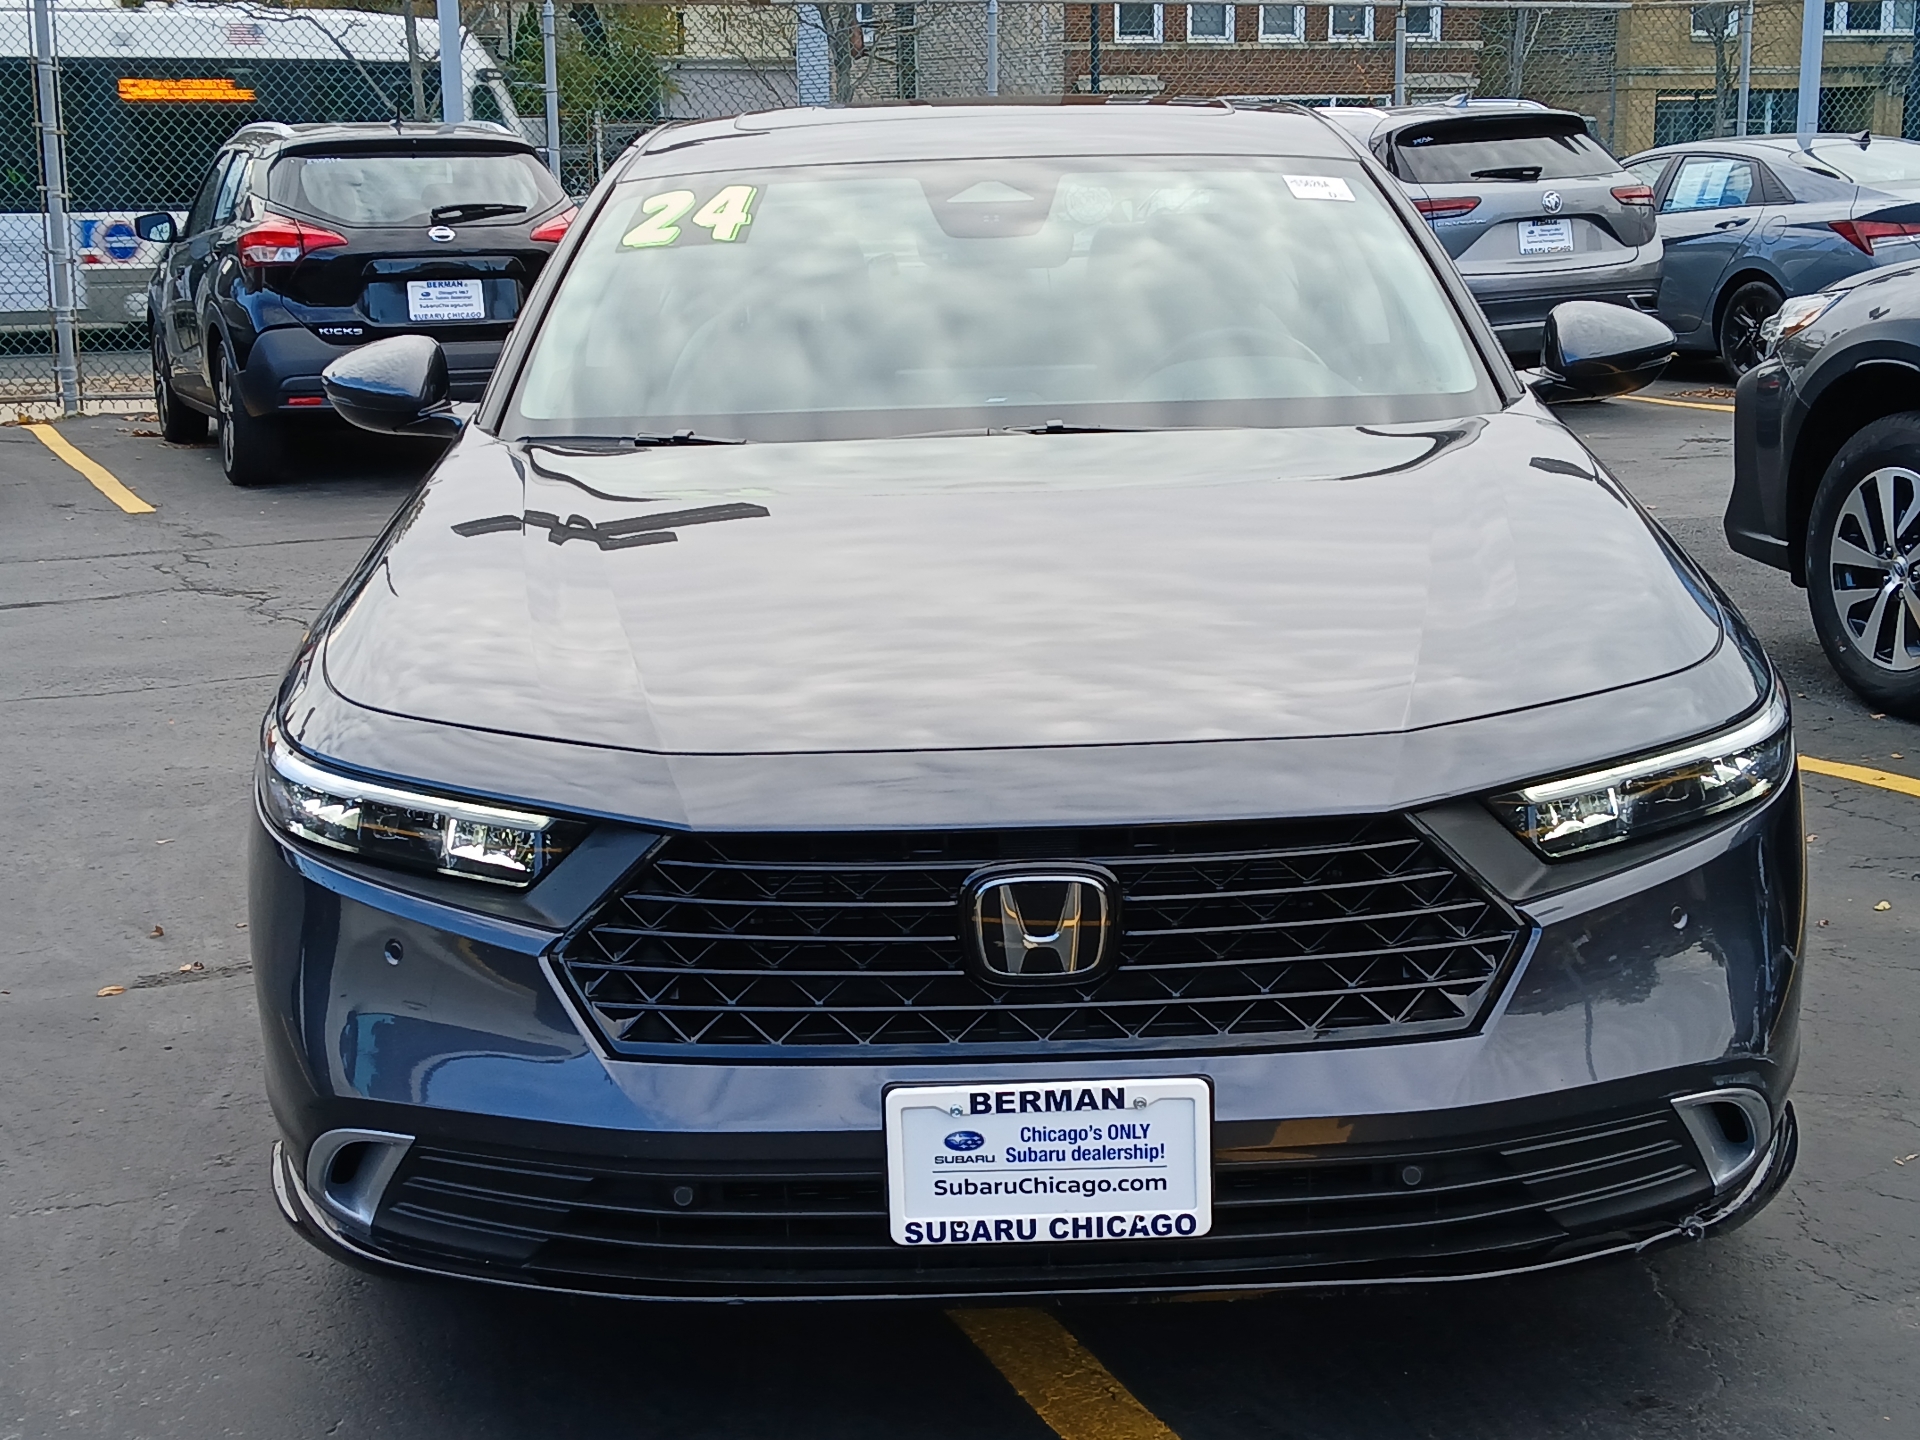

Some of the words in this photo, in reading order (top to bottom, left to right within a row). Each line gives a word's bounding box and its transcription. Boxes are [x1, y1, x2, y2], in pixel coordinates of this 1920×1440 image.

[622, 184, 757, 248] 24
[318, 327, 363, 335] KICKS
[969, 1088, 1126, 1115] BERMAN
[1020, 1125, 1103, 1145] Chicago's
[1107, 1123, 1151, 1140] ONLY
[934, 1154, 996, 1165] SUBARU
[1005, 1146, 1066, 1164] Subaru
[1071, 1143, 1166, 1163] dealership!
[933, 1176, 1168, 1197] SubaruChicago.com
[904, 1219, 1038, 1244] SUBARU
[1048, 1213, 1198, 1241] CHICAGO
